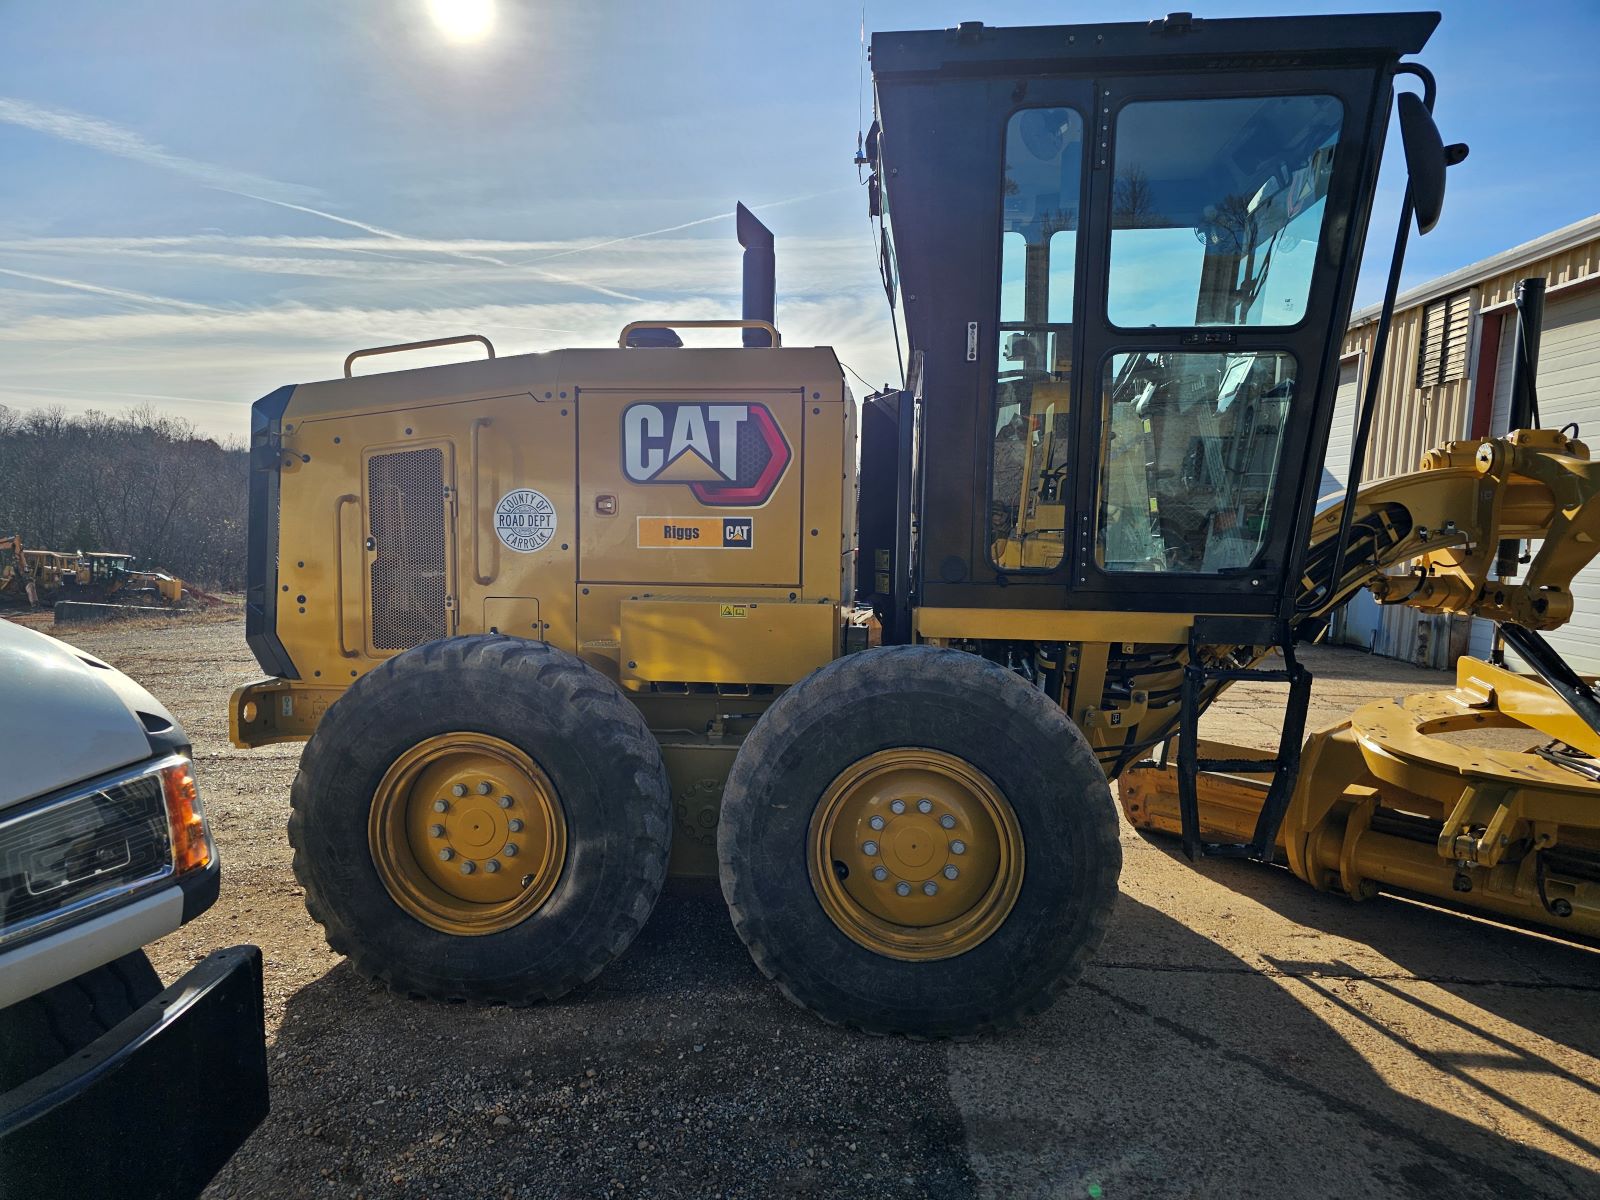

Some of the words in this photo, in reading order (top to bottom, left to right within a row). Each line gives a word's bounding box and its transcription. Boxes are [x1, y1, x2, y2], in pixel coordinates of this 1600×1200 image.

[625, 404, 747, 481] CAT
[501, 493, 536, 513] COUNTY
[535, 500, 549, 511] OF
[499, 514, 525, 527] ROAD
[527, 514, 551, 527] DEPT
[663, 525, 700, 541] Riggs
[725, 525, 750, 541] CAT
